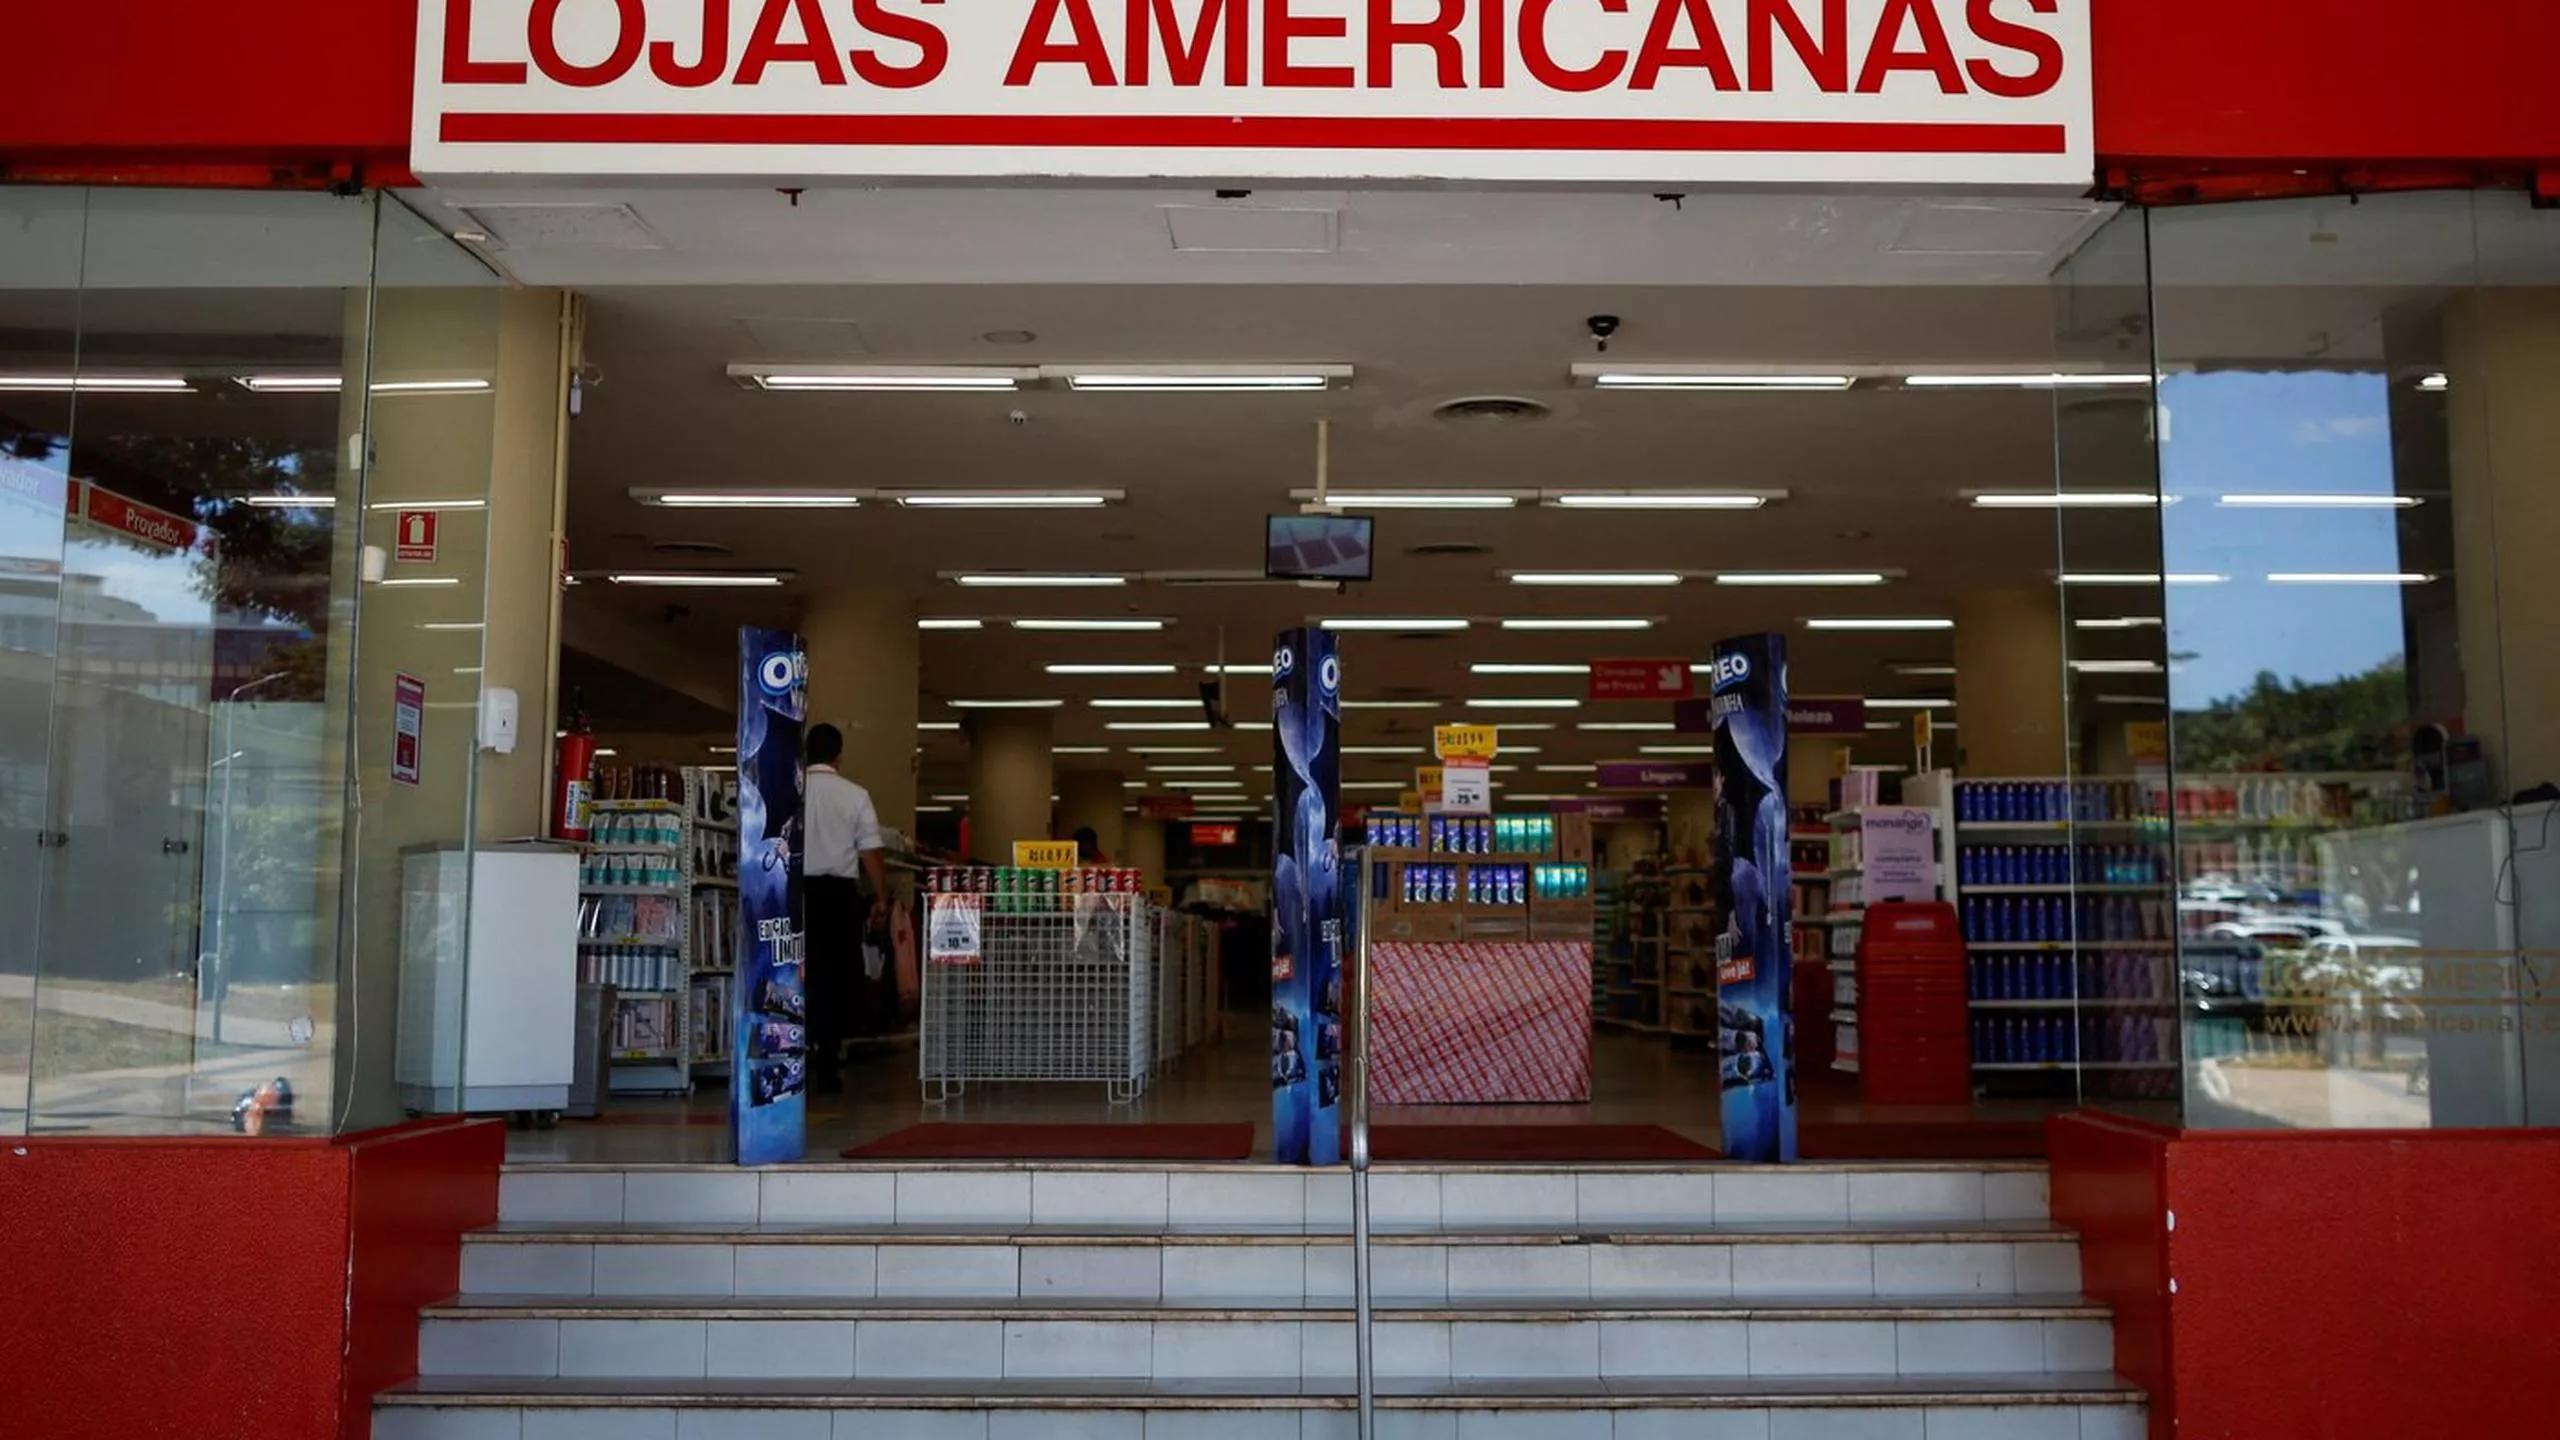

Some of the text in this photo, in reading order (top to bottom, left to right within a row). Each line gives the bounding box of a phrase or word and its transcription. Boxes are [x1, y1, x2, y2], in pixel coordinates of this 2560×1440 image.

[442, 0, 2063, 98] LOJAS AMERICANAS
[126, 508, 180, 545] Provador
